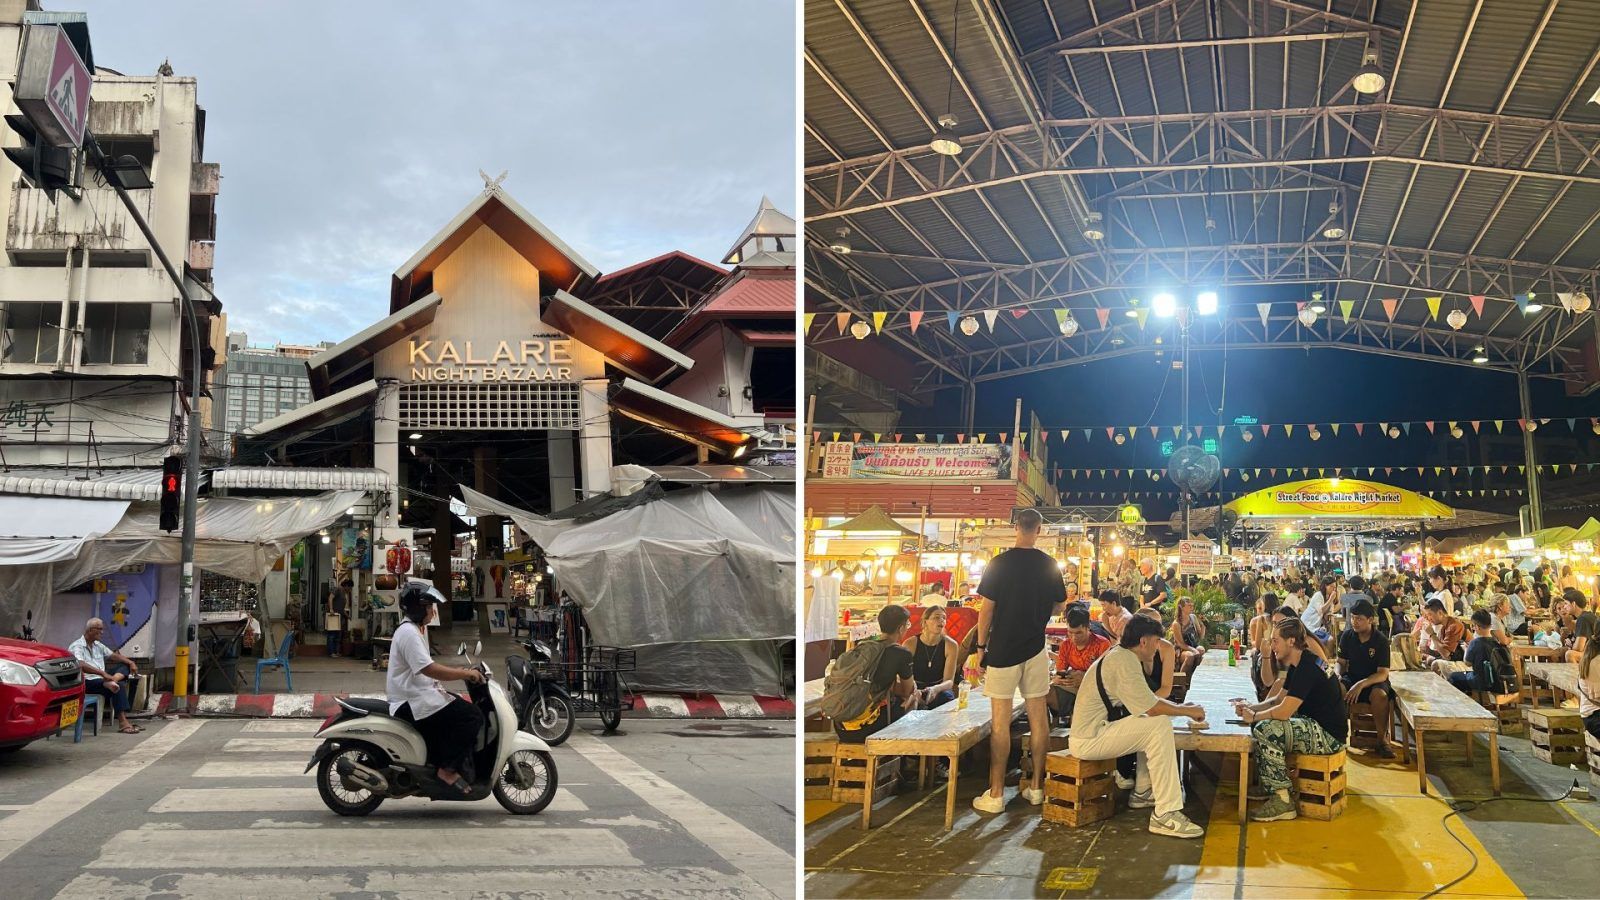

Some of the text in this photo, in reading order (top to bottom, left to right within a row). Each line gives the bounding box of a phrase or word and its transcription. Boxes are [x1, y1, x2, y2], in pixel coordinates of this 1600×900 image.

[408, 340, 573, 365] KALARE
[411, 367, 572, 382] NIGHT BAZAAR
[827, 456, 851, 464] コンサート
[936, 457, 988, 467] Welcome
[1277, 493, 1300, 502] Street
[1302, 493, 1319, 502] Food
[1354, 492, 1374, 503] Night
[1376, 493, 1400, 502] Market
